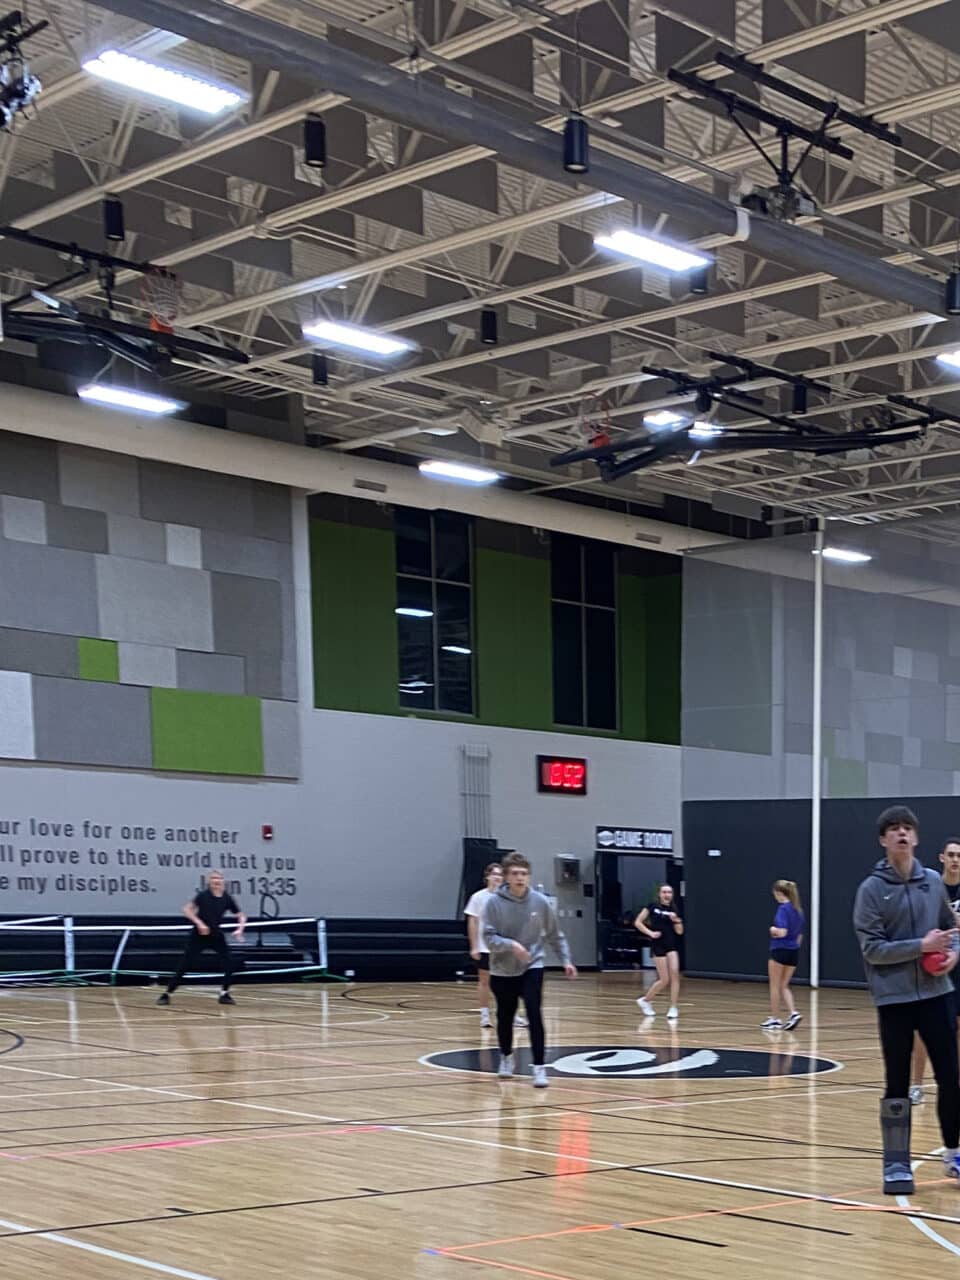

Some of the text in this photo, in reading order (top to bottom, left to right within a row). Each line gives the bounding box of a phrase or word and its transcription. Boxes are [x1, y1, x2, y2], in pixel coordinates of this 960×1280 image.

[30, 818, 74, 837] love
[83, 820, 112, 839] for
[120, 825, 156, 840] one
[165, 826, 239, 844] another
[20, 848, 80, 867] prove
[88, 848, 108, 865] to
[117, 848, 149, 866] the
[157, 851, 211, 868] world
[220, 852, 257, 869] that
[264, 856, 296, 873] you
[17, 876, 47, 895] my
[56, 874, 157, 895] disciples.
[247, 877, 296, 896] 13:35
